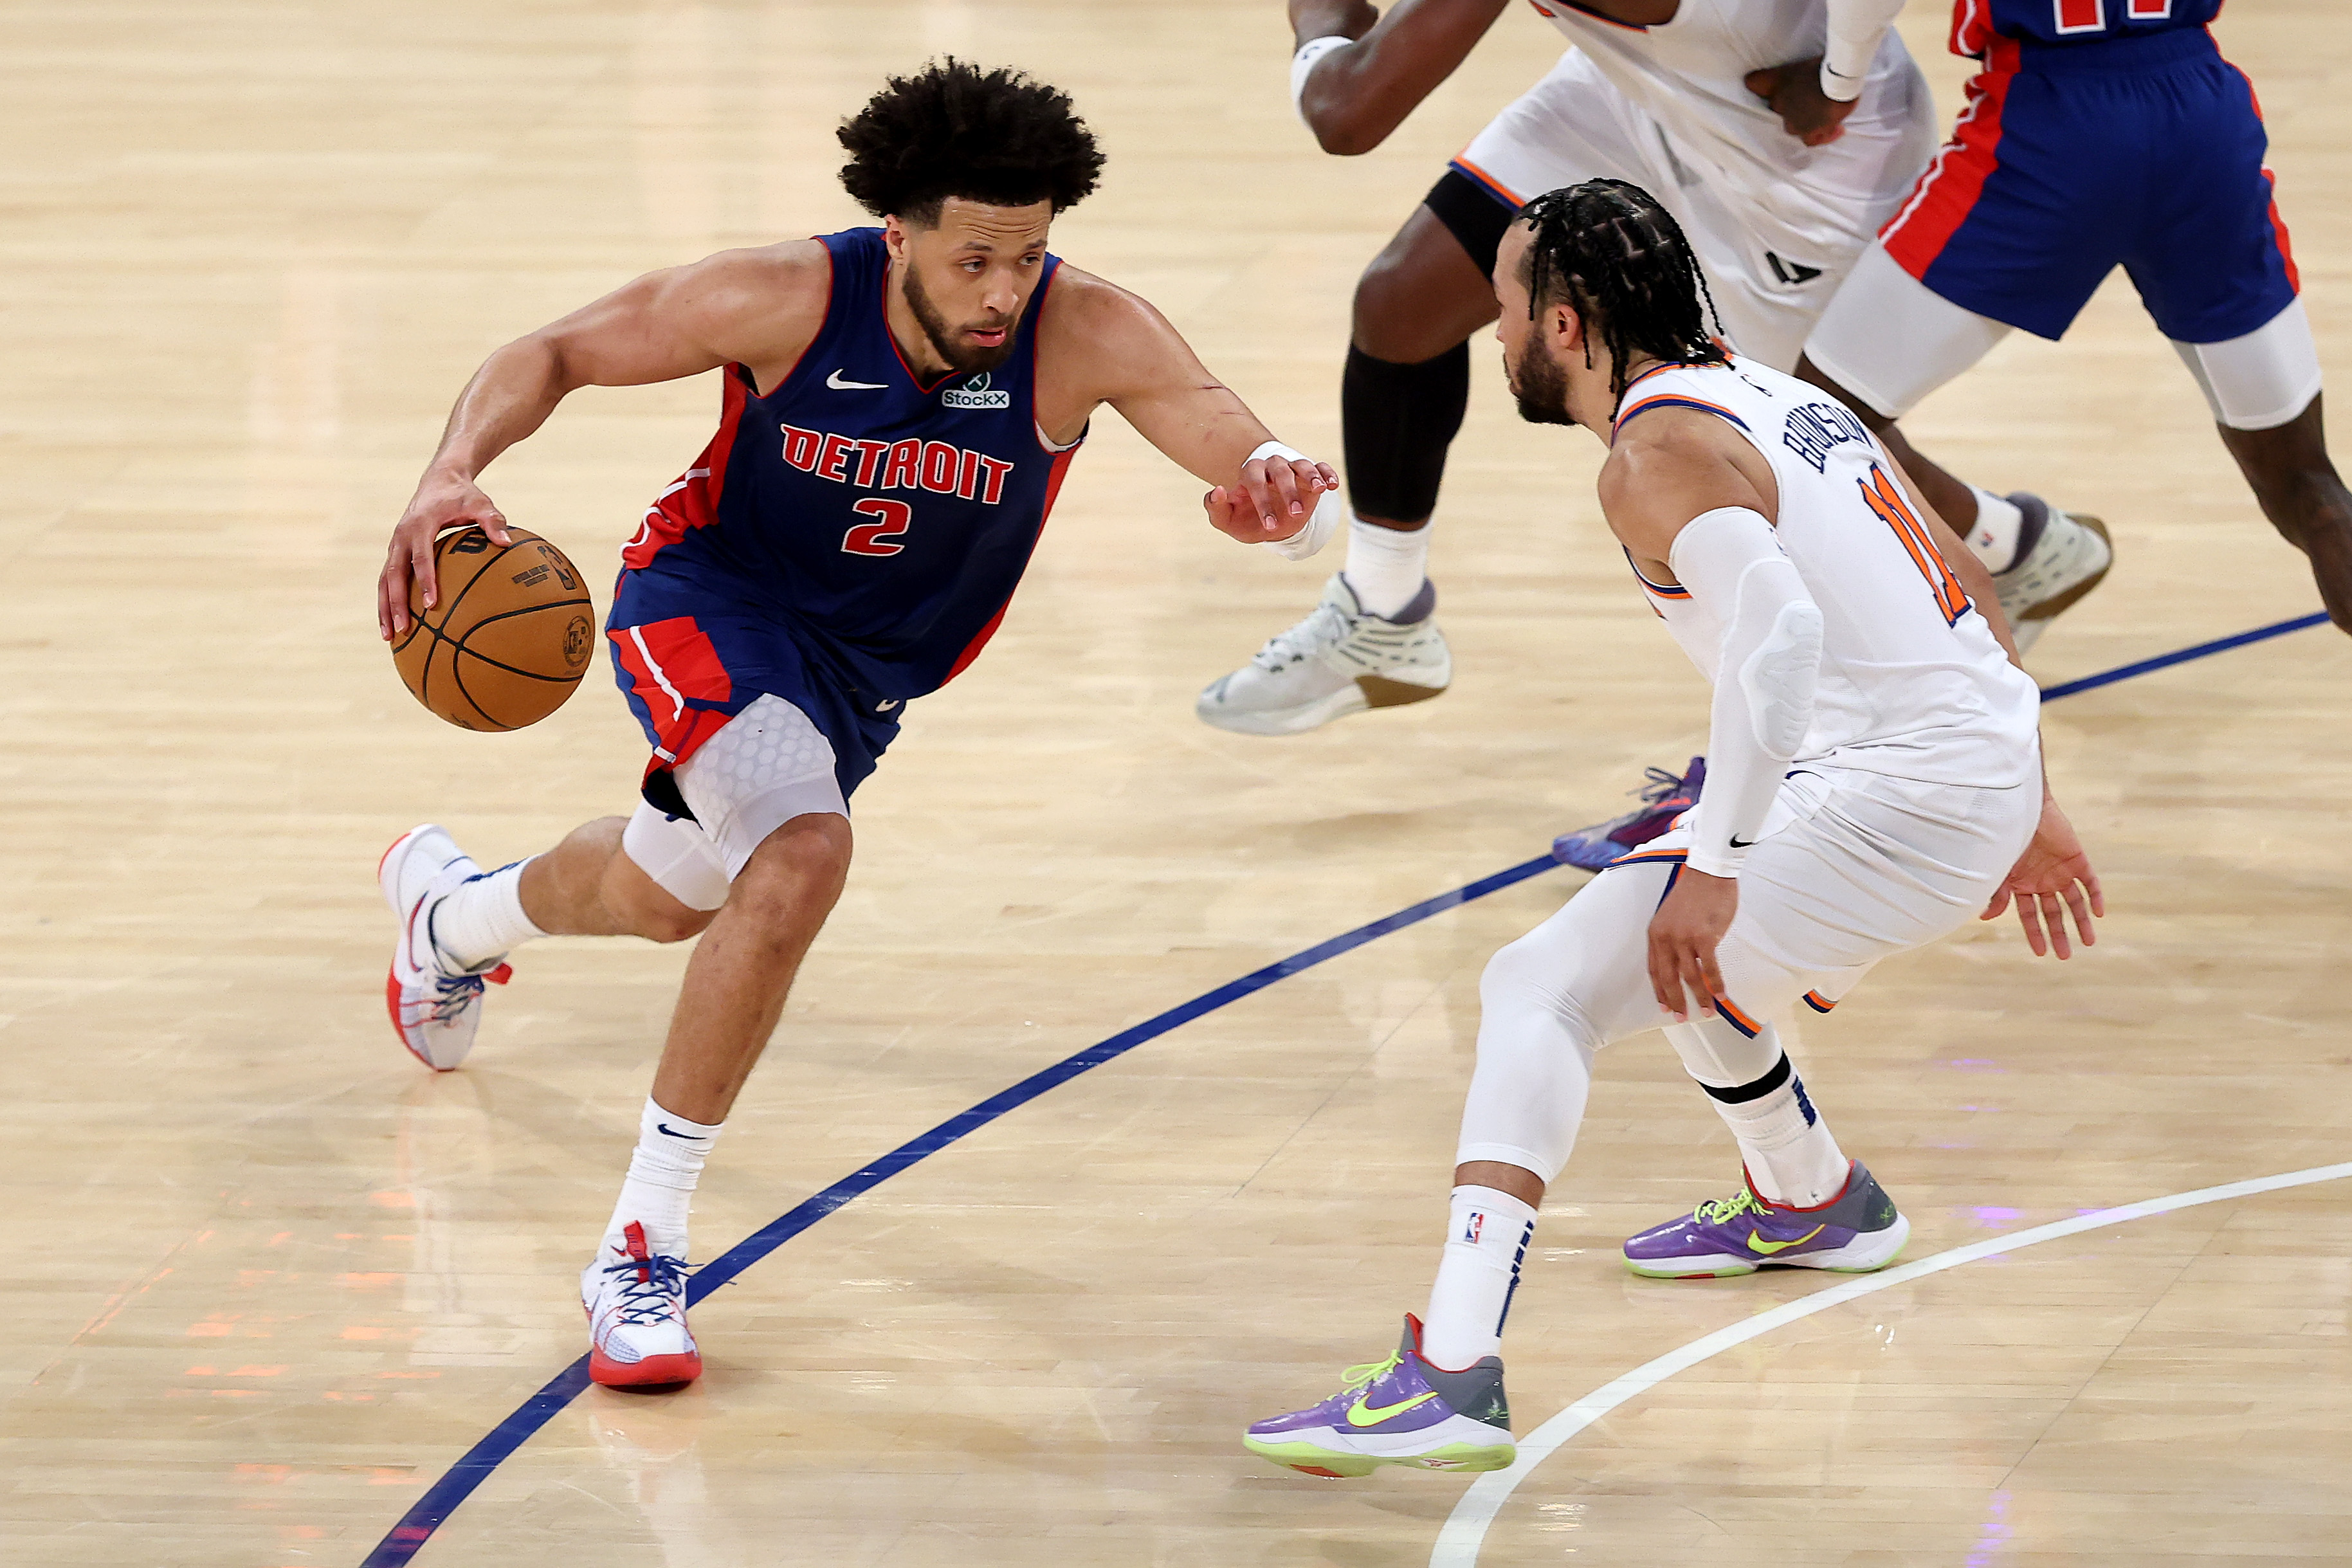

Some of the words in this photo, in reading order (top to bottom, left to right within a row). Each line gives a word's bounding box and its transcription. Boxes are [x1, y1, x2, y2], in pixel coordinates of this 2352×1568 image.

[945, 392, 1006, 406] StockX
[780, 423, 1014, 505] DETROIT
[1783, 403, 1874, 474] BRUNSON
[841, 497, 912, 557] 2
[1857, 461, 1972, 629] 11
